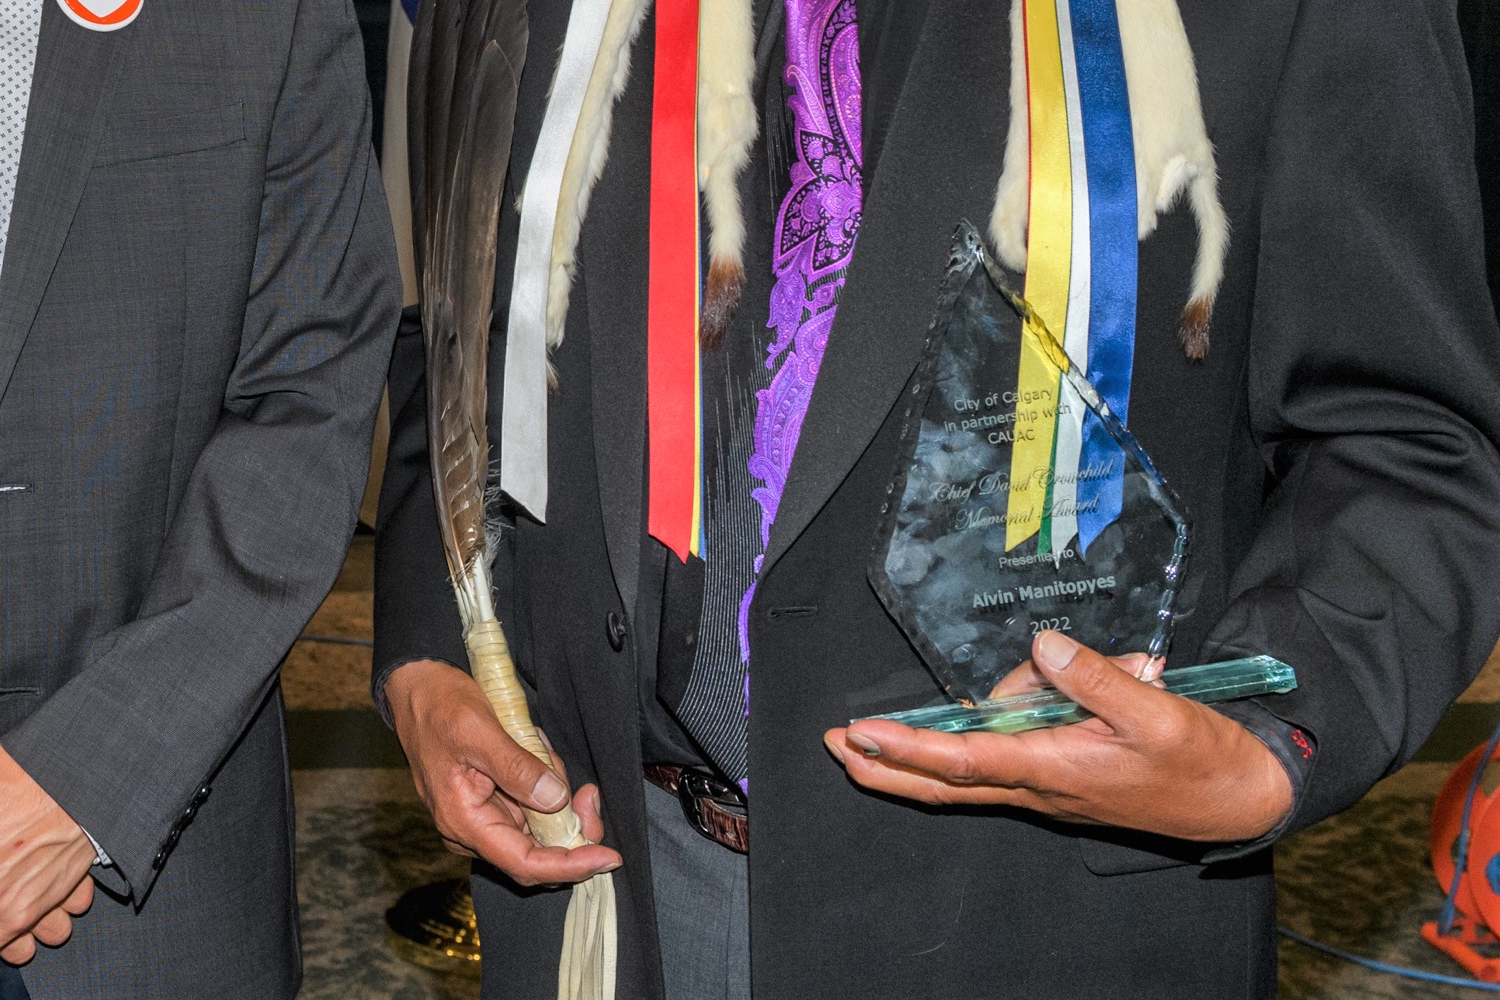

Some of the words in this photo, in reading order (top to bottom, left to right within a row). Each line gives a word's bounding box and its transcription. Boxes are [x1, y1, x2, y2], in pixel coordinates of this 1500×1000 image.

[954, 398, 980, 412] City
[985, 393, 999, 406] of
[1002, 387, 1054, 404] Calgary
[943, 420, 957, 432] in
[961, 409, 1038, 431] partnership
[988, 429, 1035, 444] CAUAC
[929, 480, 977, 504] Chief
[978, 472, 1031, 495] David
[1033, 459, 1114, 489] Crowchild
[954, 506, 1035, 531] Memorial
[1037, 494, 1100, 519] Award
[1062, 548, 1075, 559] to
[972, 589, 1015, 608] Alvin
[1018, 575, 1116, 601] Manitopyes
[1030, 616, 1072, 635] 2022
